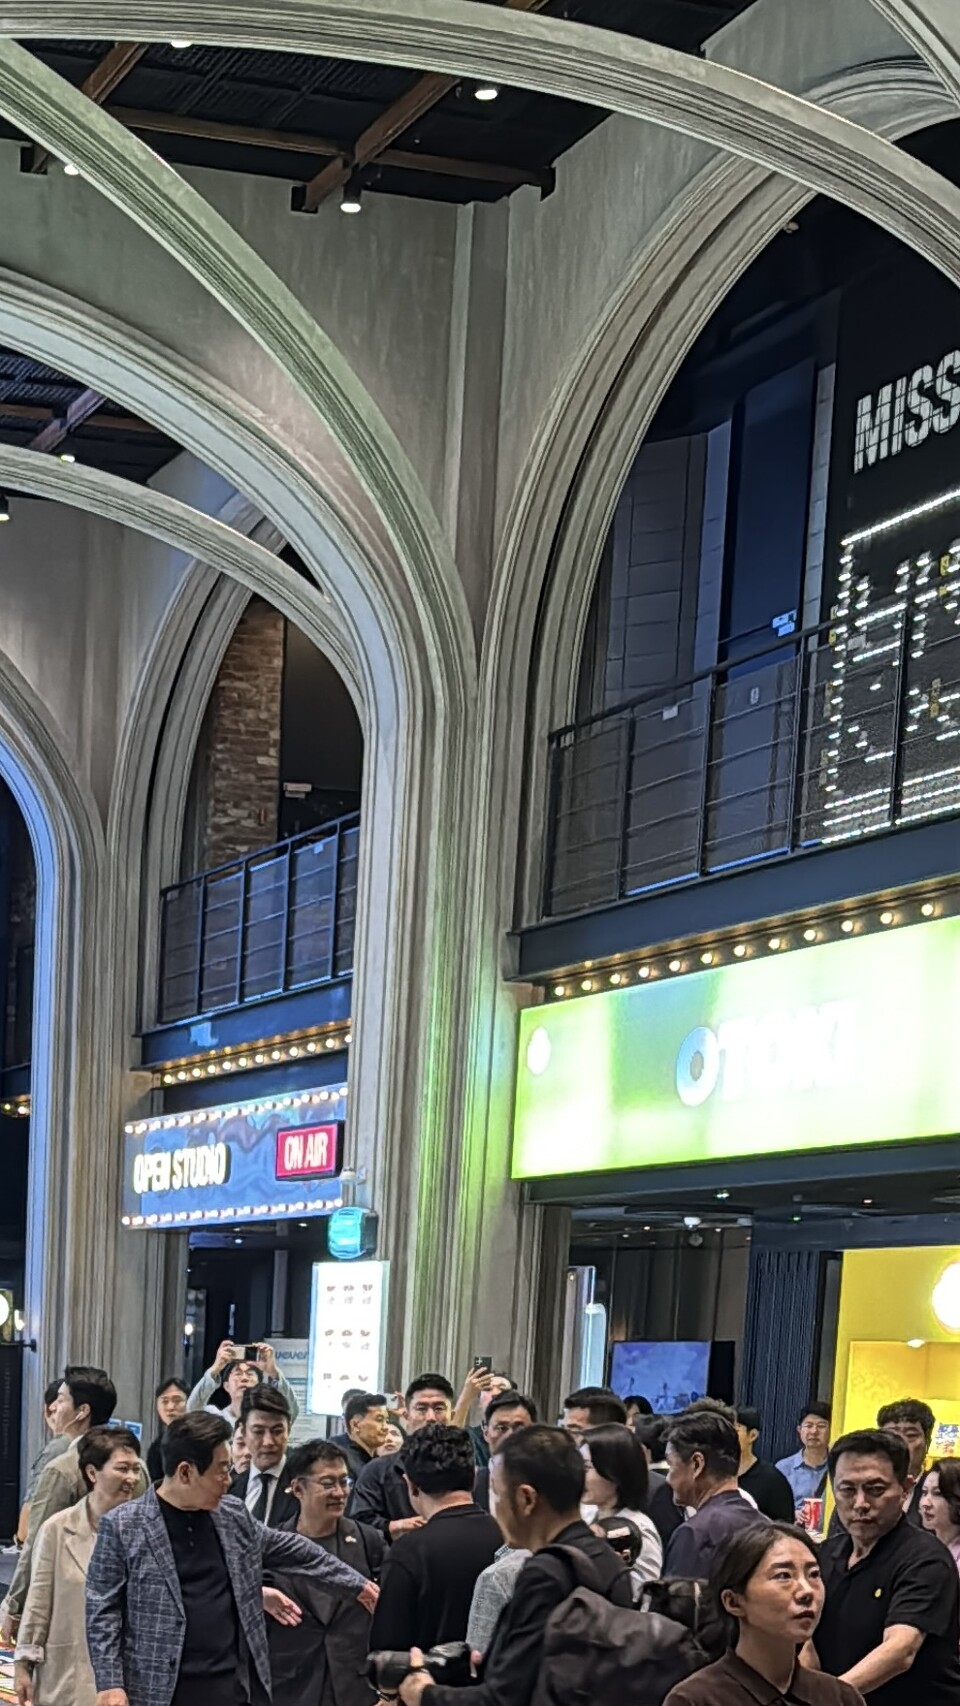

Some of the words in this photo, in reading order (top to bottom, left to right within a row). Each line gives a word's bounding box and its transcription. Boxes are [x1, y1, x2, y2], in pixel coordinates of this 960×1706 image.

[133, 1151, 171, 1194] OPEN
[172, 1142, 227, 1190] STUDIO
[284, 1134, 303, 1171] ON
[304, 1131, 329, 1168] AIR
